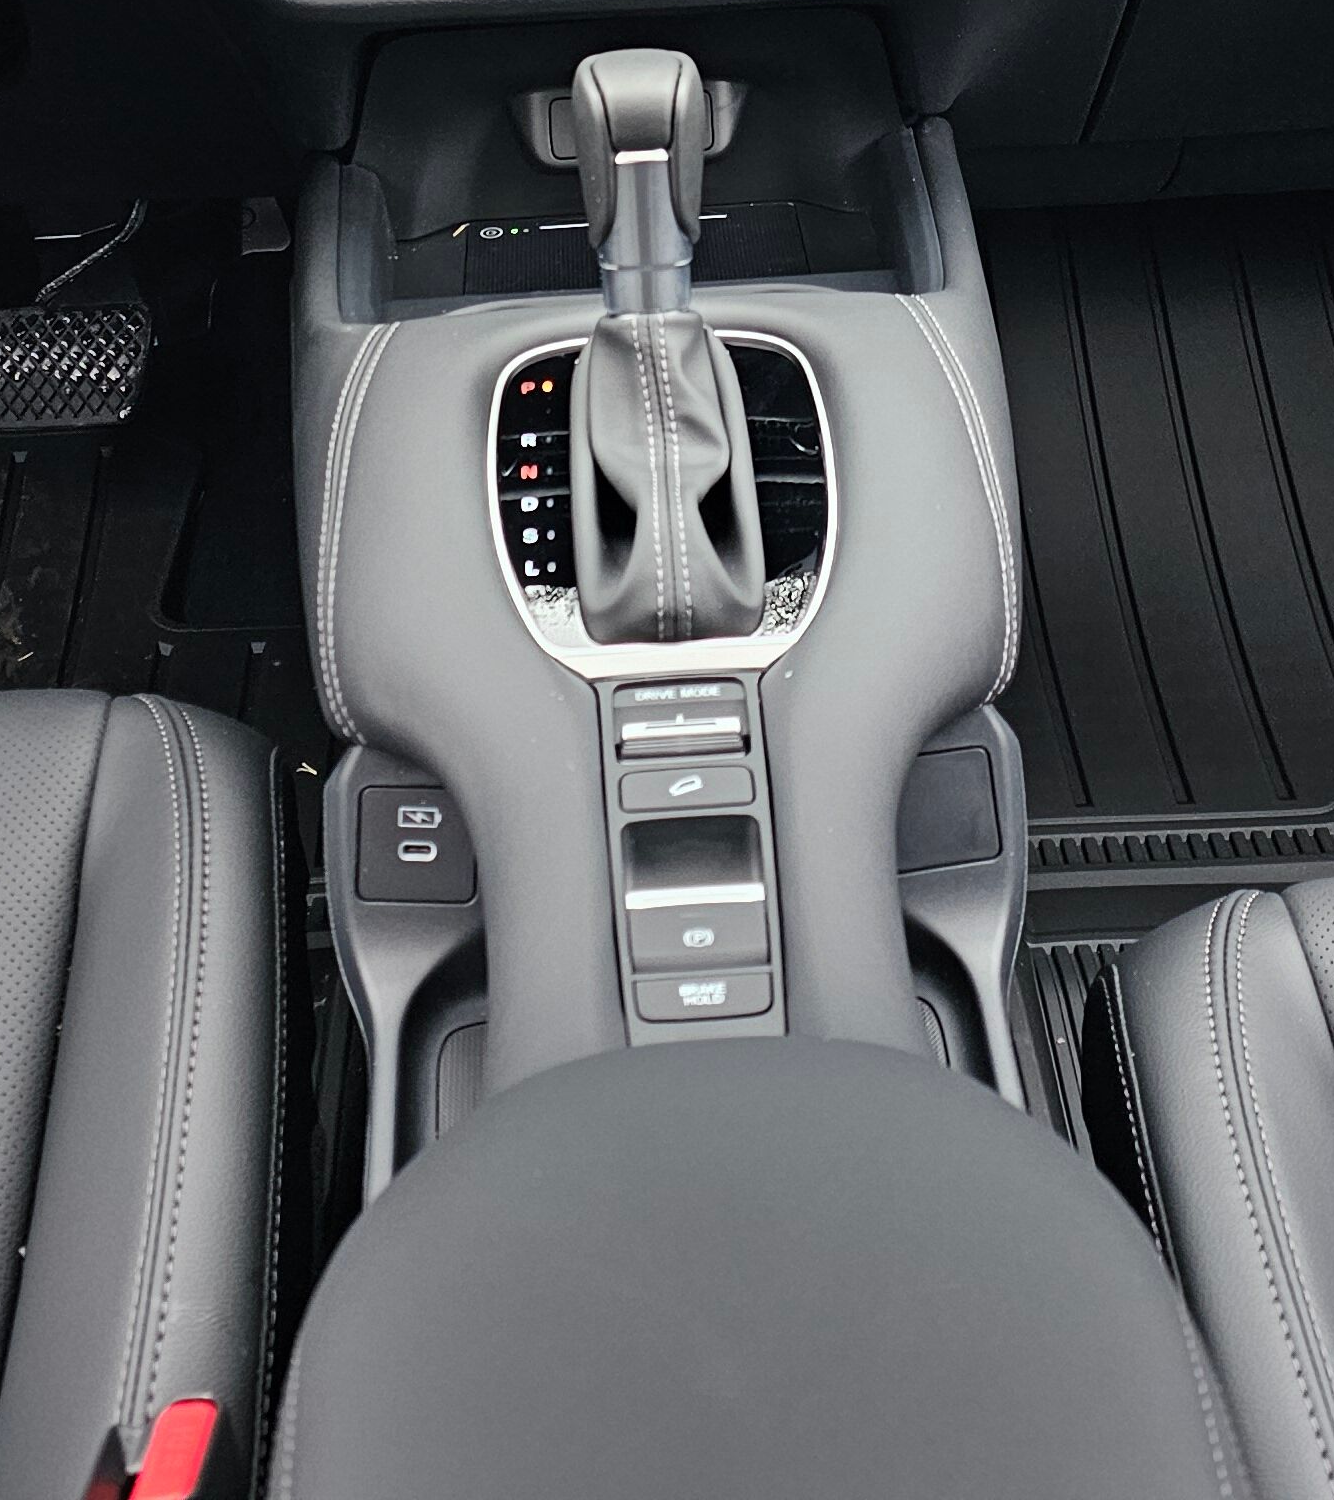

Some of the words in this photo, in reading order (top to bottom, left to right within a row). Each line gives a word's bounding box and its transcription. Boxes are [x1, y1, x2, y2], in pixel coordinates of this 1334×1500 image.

[521, 381, 535, 394] P
[521, 433, 536, 447] R
[521, 465, 537, 479] N
[521, 497, 538, 511] D
[525, 560, 540, 576] L
[635, 689, 676, 701] DRIVE
[680, 686, 721, 698] MODE
